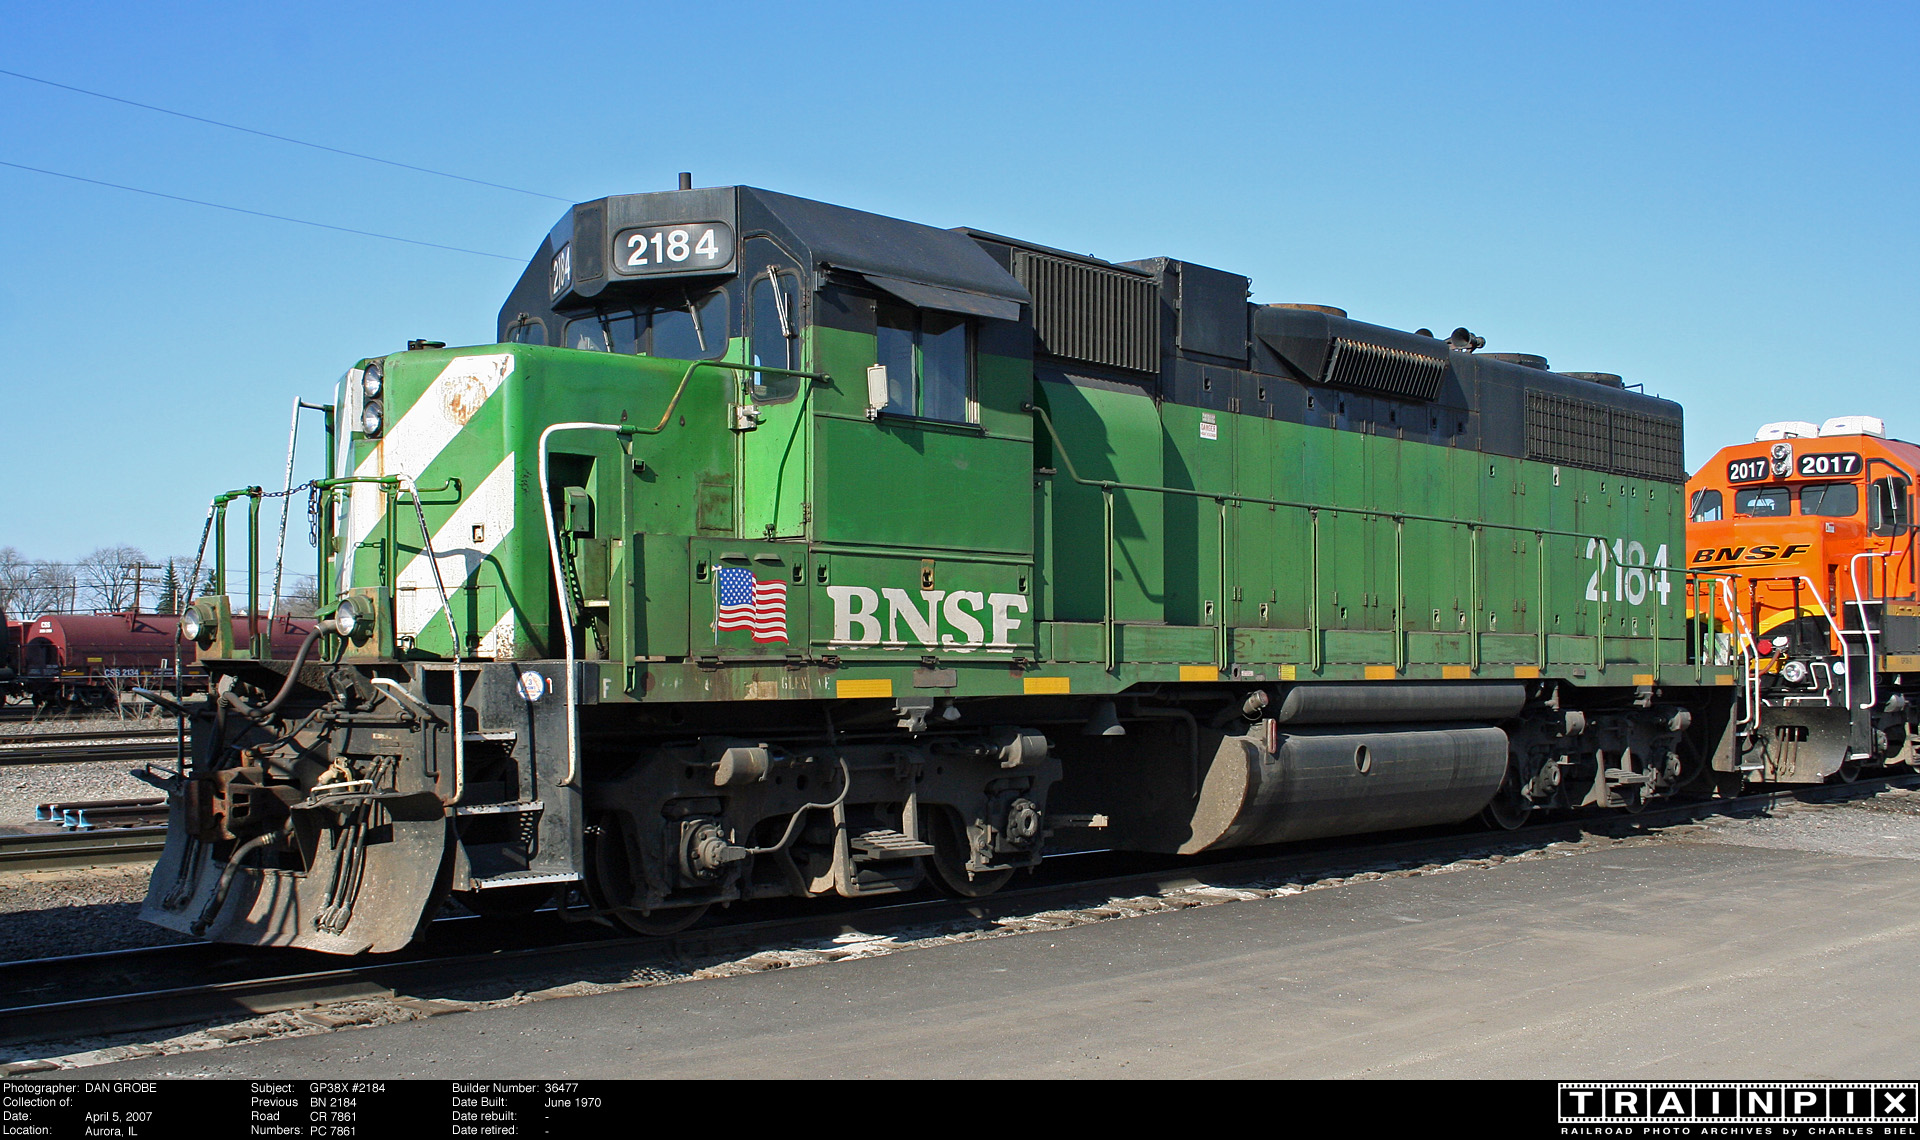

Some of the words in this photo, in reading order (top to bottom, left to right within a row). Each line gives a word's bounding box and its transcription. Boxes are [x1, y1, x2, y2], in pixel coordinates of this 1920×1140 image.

[627, 229, 719, 266] 2184
[553, 246, 571, 295] 2184
[1730, 461, 1766, 480] 2017
[1801, 455, 1856, 474] 2017
[1691, 543, 1813, 564] BNSF
[1584, 537, 1671, 606] 2184
[826, 585, 1029, 654] BNSF
[104, 668, 120, 677] CSS
[122, 668, 139, 677] 2134
[602, 678, 612, 699] F
